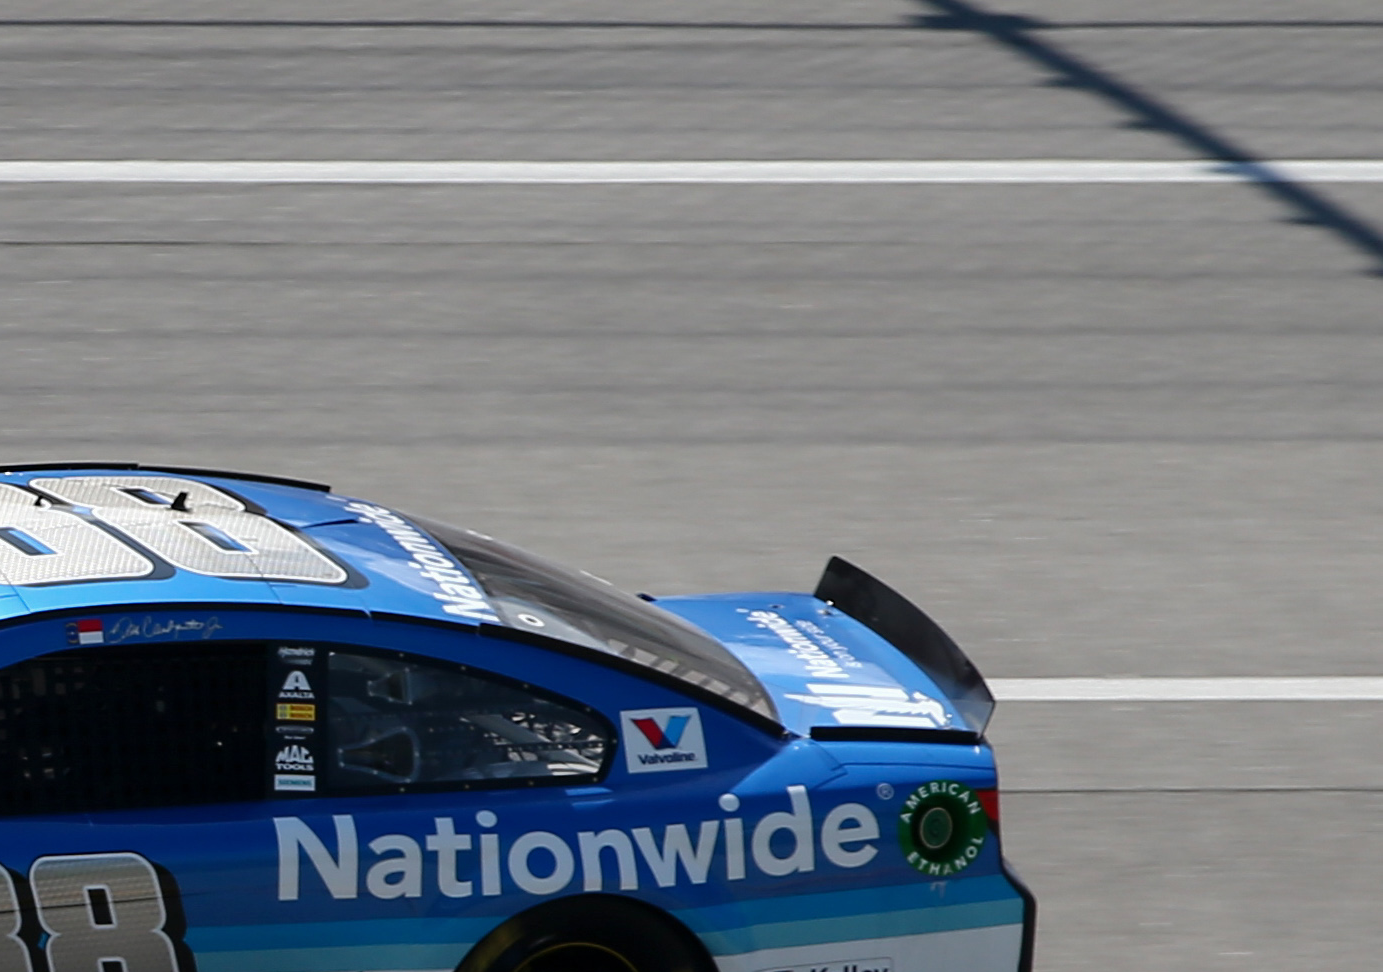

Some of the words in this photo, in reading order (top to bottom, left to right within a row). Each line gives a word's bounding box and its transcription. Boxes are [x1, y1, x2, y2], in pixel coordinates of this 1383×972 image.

[344, 502, 500, 622] Nationwide
[746, 610, 850, 678] Nationwide
[275, 744, 314, 763] MAC
[275, 763, 314, 771] TOOLS
[638, 751, 696, 765] Valvoline
[900, 782, 982, 824] AMERICAN
[273, 784, 881, 901] Nationwide
[907, 837, 985, 875] ETHANOL
